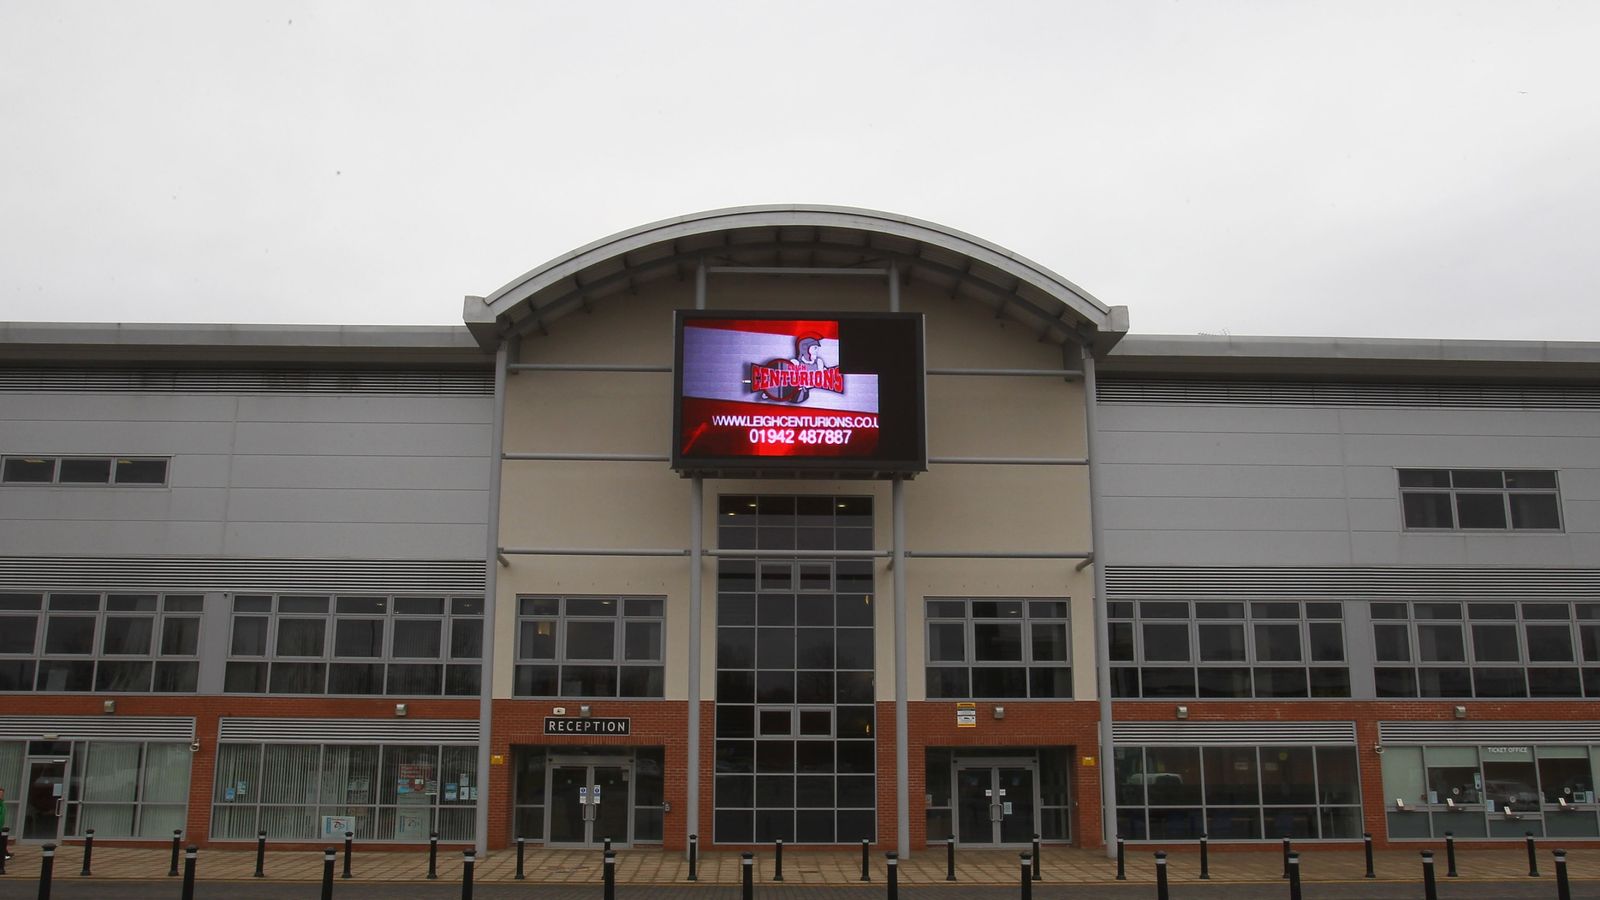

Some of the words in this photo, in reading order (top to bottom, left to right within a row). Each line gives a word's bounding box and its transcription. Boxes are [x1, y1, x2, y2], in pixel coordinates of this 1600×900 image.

[752, 366, 843, 392] CENTURIONS
[750, 430, 794, 444] 01942
[798, 430, 852, 444] 487887
[549, 721, 625, 731] RECEPTION
